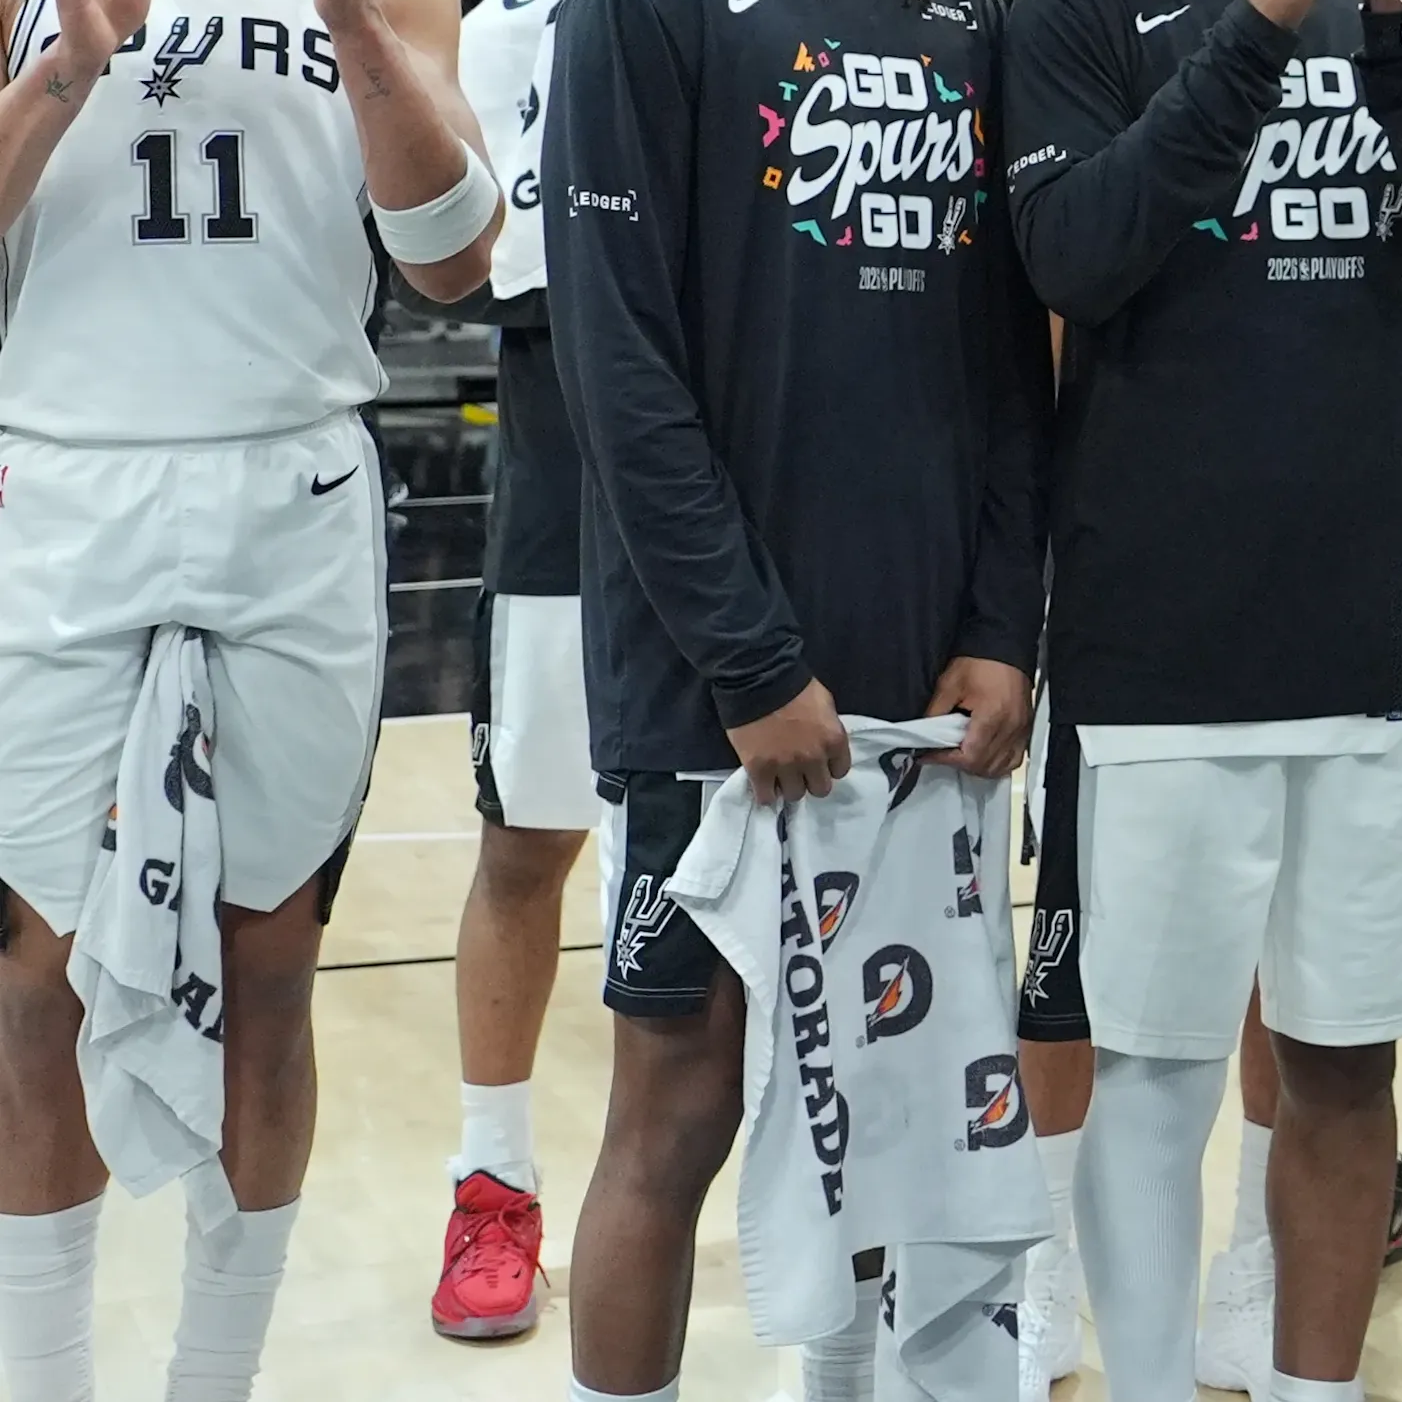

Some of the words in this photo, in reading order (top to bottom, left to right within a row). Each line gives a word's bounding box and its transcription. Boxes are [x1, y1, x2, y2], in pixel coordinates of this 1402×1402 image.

[842, 52, 929, 111] GO
[786, 73, 975, 220] Spurs
[131, 130, 258, 244] 11
[573, 190, 632, 212] LEDGER
[1270, 186, 1371, 241] GO
[860, 192, 934, 249] GO
[1267, 258, 1299, 282] 2026
[1310, 256, 1365, 281] PLAYOFFS
